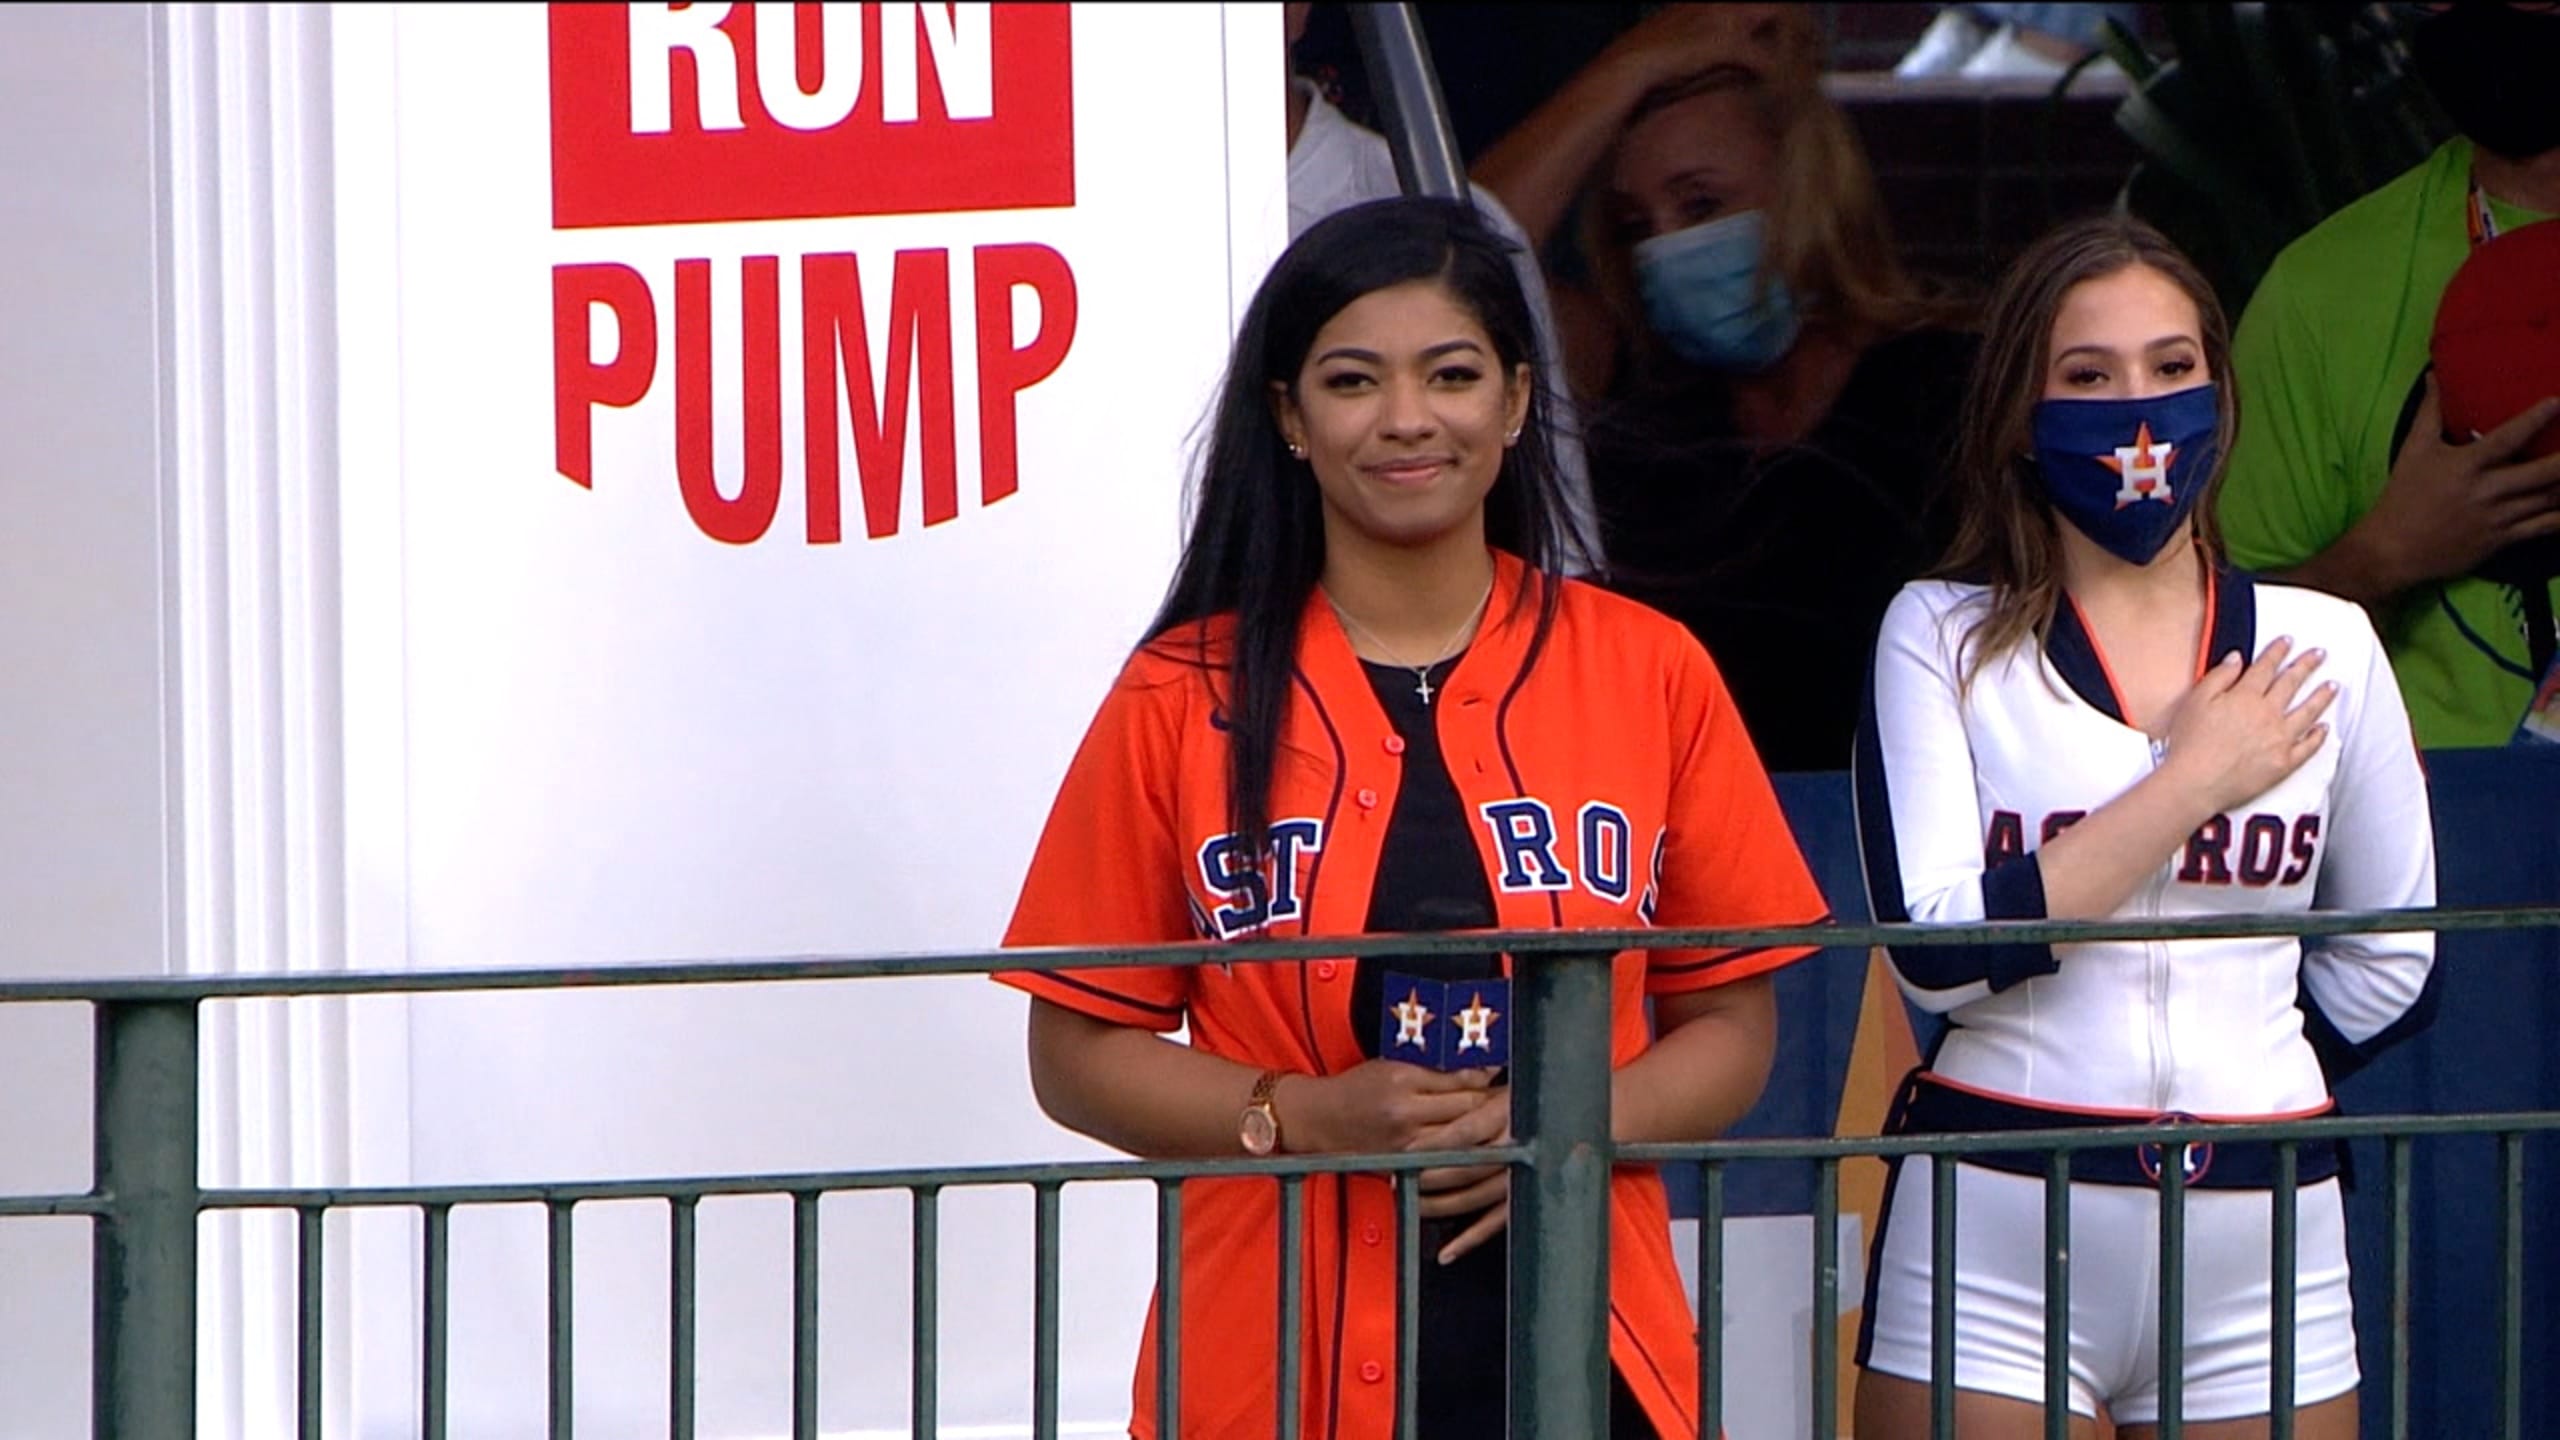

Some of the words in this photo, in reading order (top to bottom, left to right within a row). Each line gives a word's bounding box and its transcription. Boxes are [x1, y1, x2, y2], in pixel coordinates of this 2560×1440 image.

[629, 2, 996, 135] RUN
[552, 241, 1078, 545] PUMP
[2114, 442, 2173, 500] H
